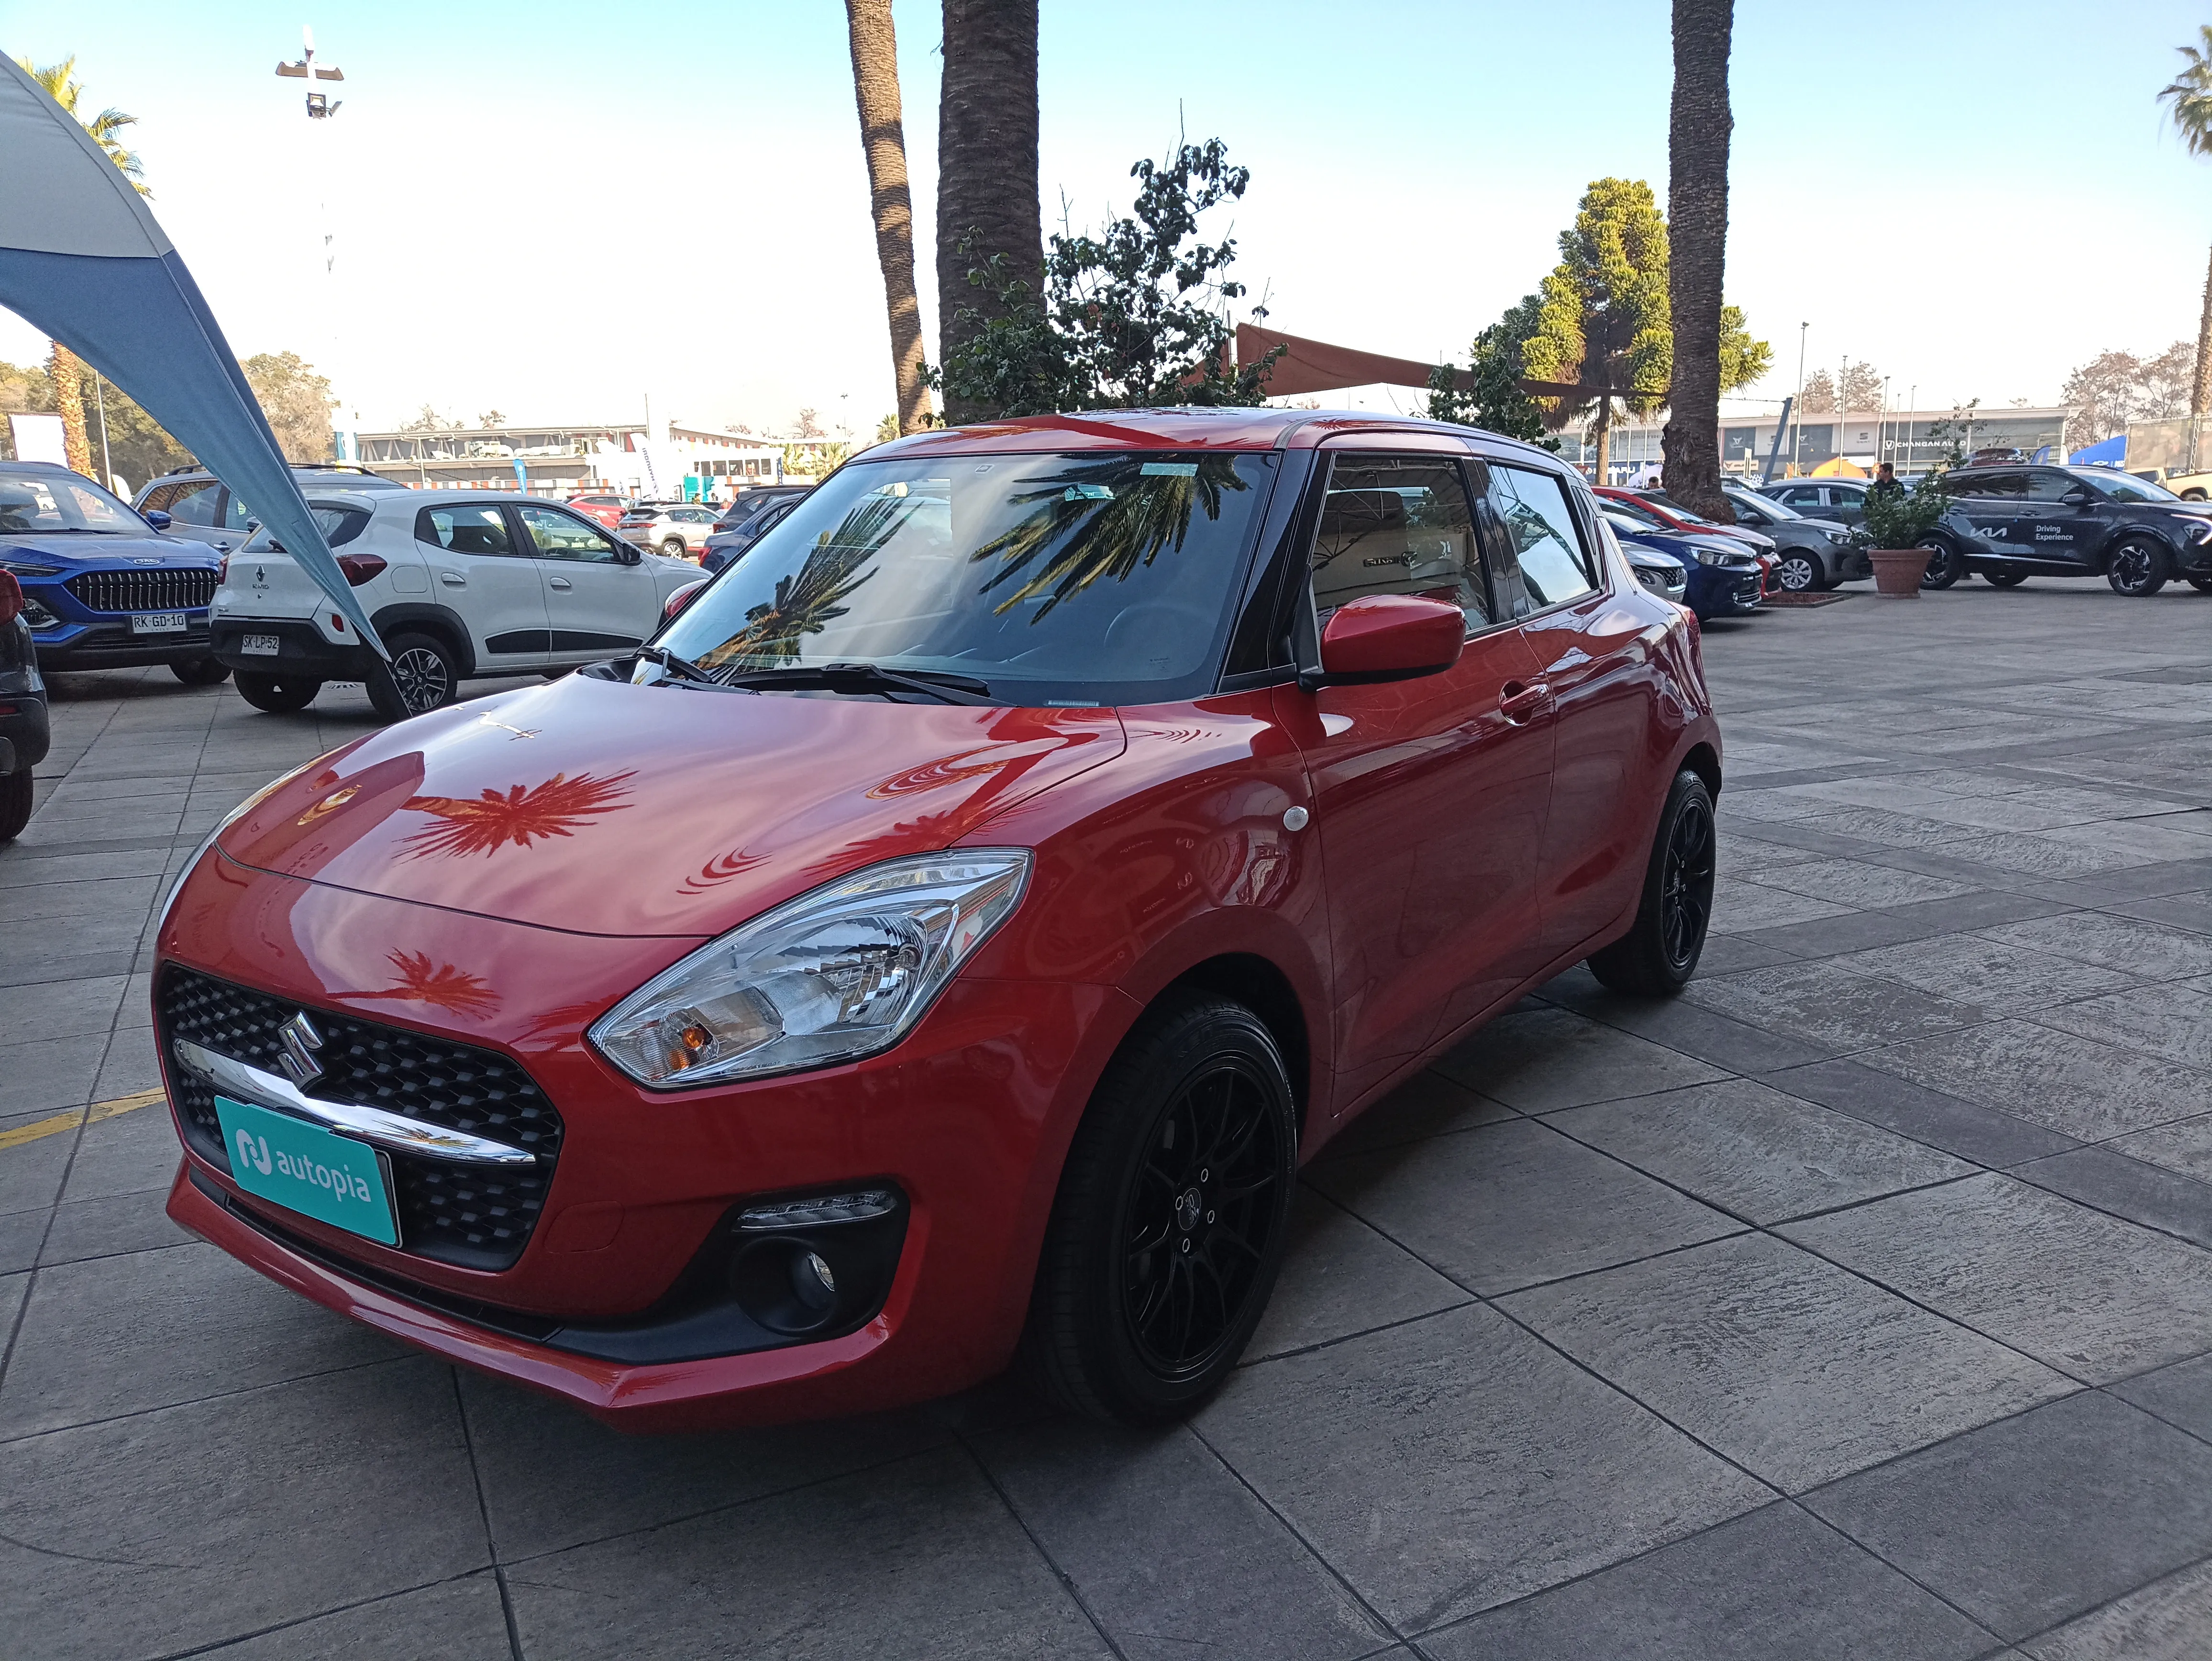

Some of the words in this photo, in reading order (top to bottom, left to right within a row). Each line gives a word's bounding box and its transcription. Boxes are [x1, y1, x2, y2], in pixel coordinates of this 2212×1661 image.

[2036, 525, 2061, 533] Driving
[2036, 533, 2074, 542] Experience
[276, 1151, 372, 1203] autopia
